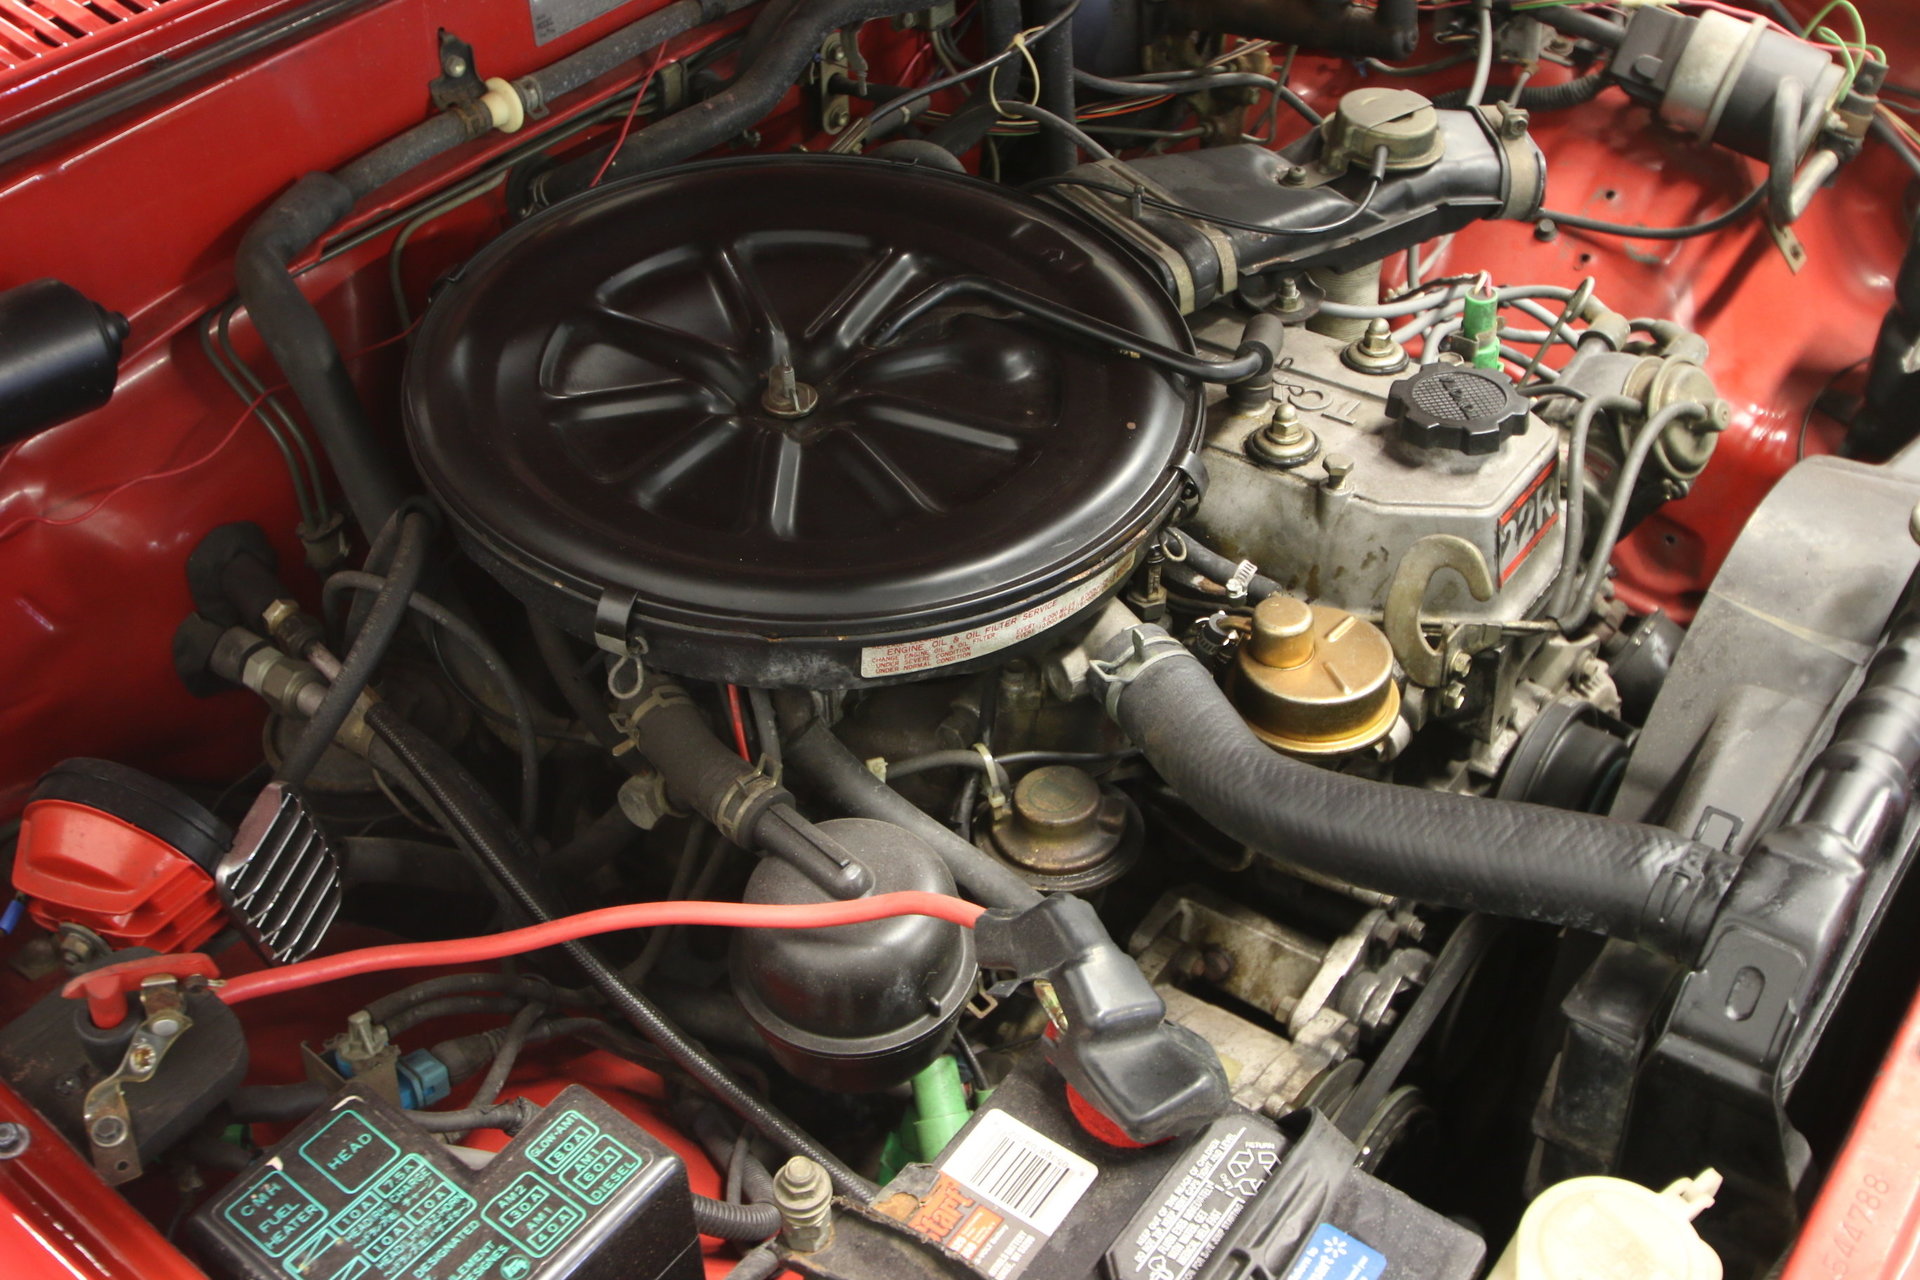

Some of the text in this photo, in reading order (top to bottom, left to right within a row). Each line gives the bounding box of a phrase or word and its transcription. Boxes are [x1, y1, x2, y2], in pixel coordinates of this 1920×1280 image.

[887, 643, 924, 655] ENGINE
[931, 639, 946, 648] OIL
[953, 635, 960, 643] &
[965, 630, 981, 640] OIL
[984, 617, 1018, 634] FILTER
[1022, 600, 1057, 621] SERVICE
[872, 655, 899, 664] CHANGE
[904, 650, 929, 660] ENGINE
[972, 632, 997, 644] FILTER
[875, 661, 899, 669] UNDER
[904, 656, 931, 665] SEVERE
[935, 646, 971, 659] CONDITION
[875, 666, 899, 674] UNDER
[903, 662, 931, 671] NORMAL
[936, 652, 971, 665] CONDITION
[327, 1133, 372, 1168] HEAD
[575, 1149, 601, 1173] AM1
[1244, 1141, 1276, 1150] RETURN
[388, 1168, 431, 1202] CHARGE
[497, 1184, 526, 1207] AM2
[590, 1162, 638, 1201] DIESEL
[240, 1183, 281, 1216] CMH
[259, 1203, 299, 1232] FUEL
[263, 1202, 319, 1252] HEATER
[526, 1207, 551, 1229] AM1
[414, 1219, 479, 1277] DESIGNATED
